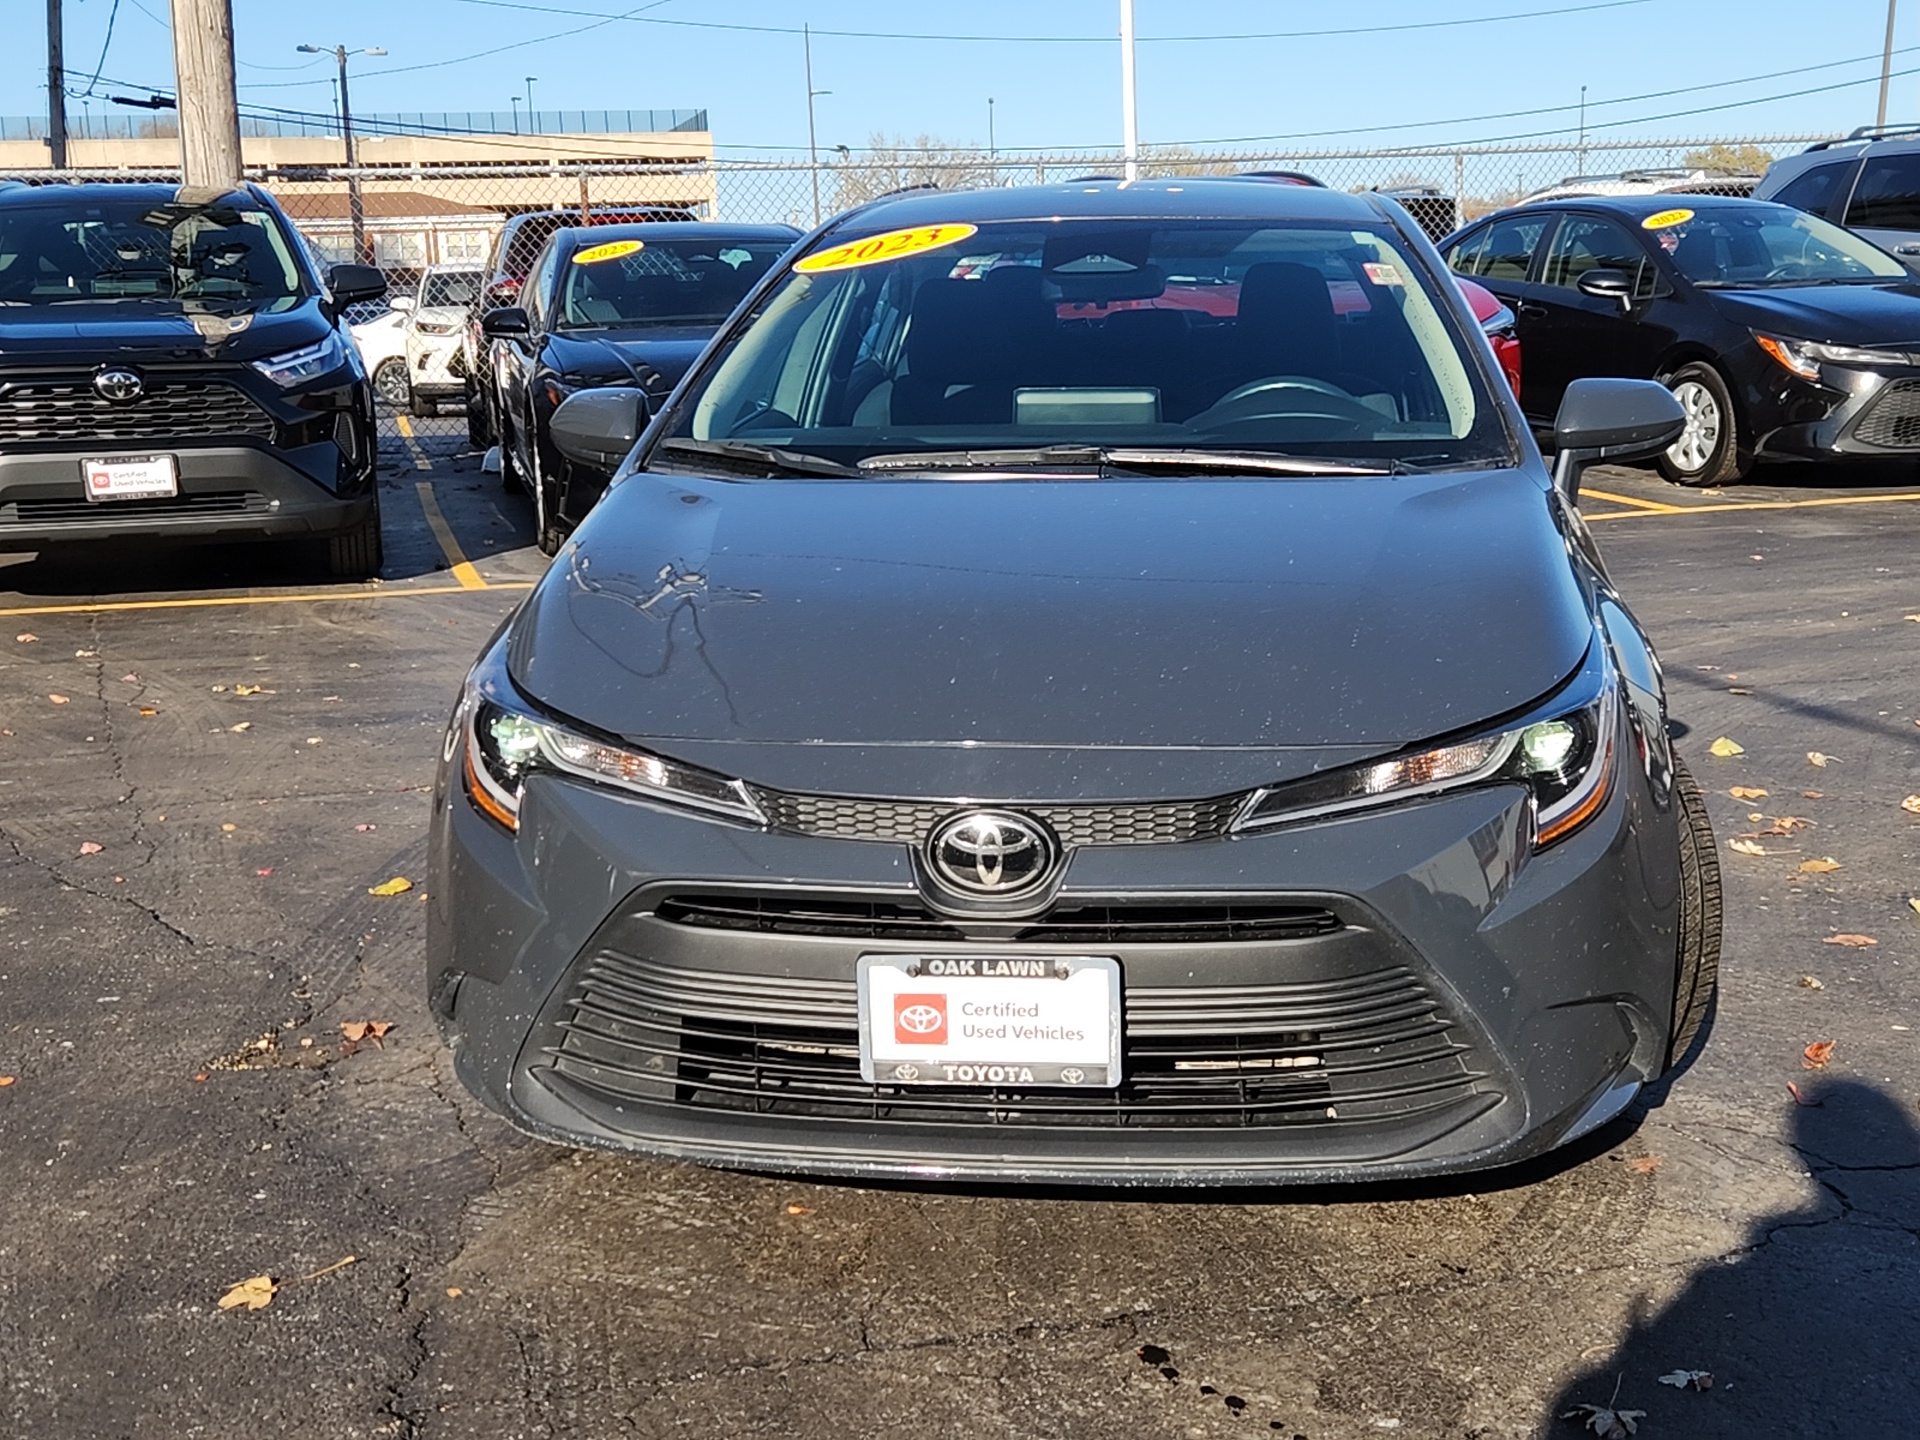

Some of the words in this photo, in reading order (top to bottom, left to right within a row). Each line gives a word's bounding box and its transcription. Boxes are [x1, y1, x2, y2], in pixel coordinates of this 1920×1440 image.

[588, 243, 629, 260] 2025
[824, 228, 943, 267] 2023
[928, 960, 976, 976] OAK
[982, 960, 1045, 977] LAWN
[961, 1002, 1039, 1018] Certified
[962, 1024, 1007, 1039] Used
[1011, 1025, 1085, 1041] Vehicles
[942, 1065, 1034, 1083] TOYOTA
